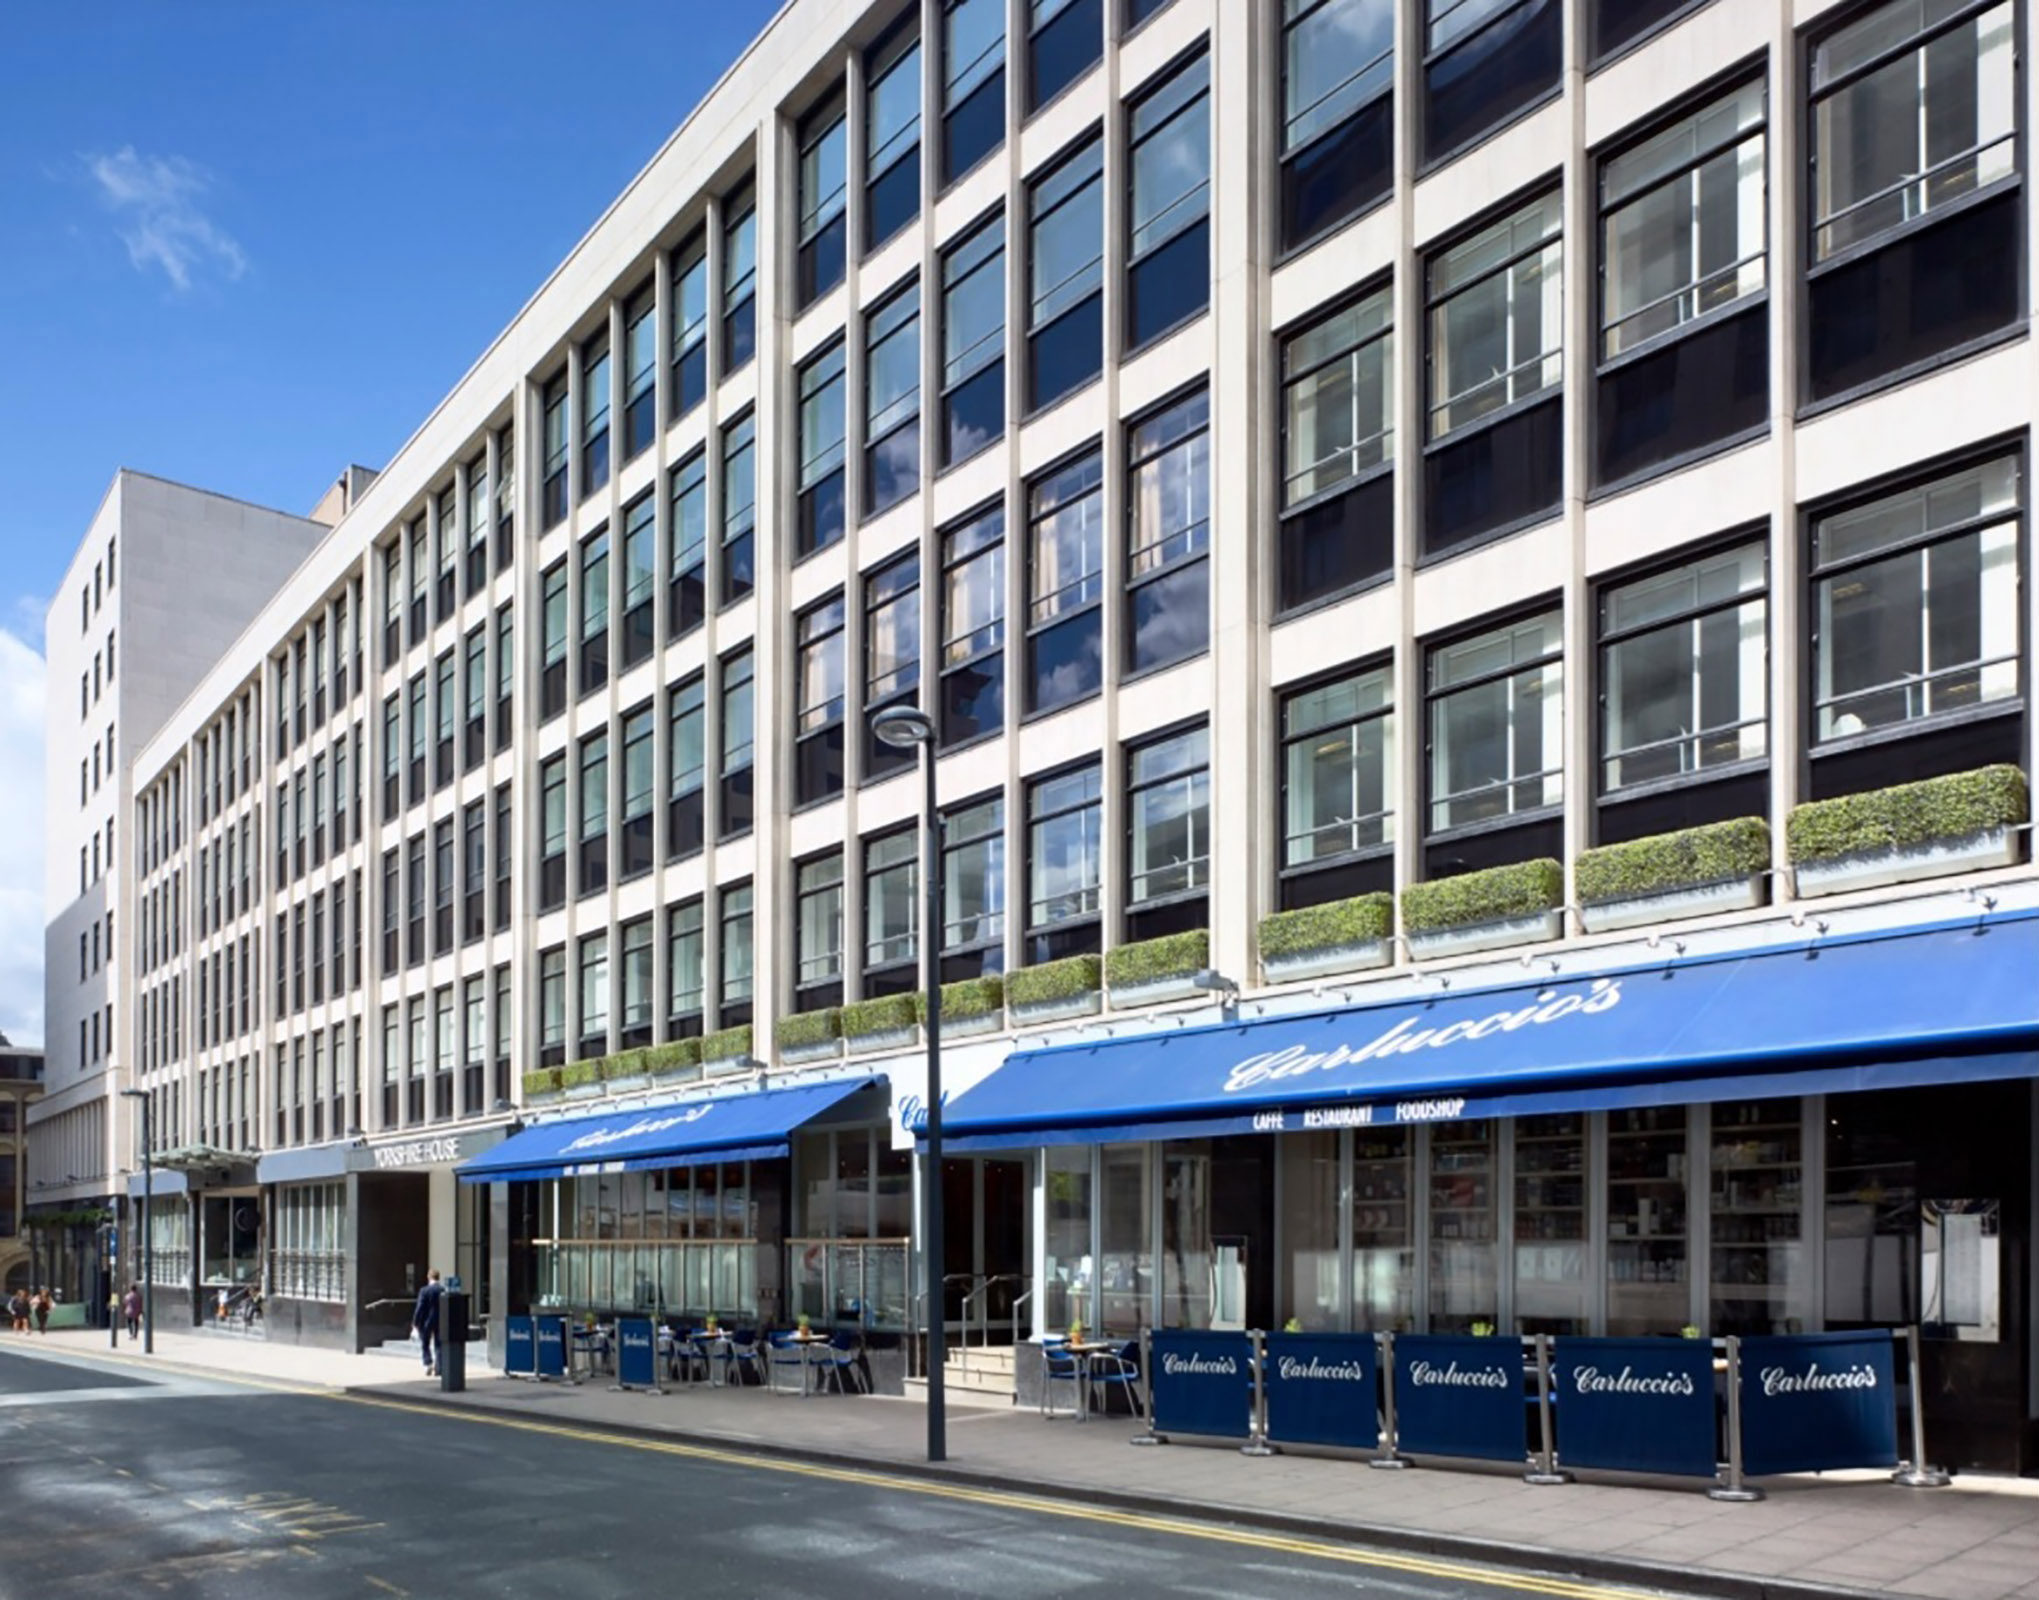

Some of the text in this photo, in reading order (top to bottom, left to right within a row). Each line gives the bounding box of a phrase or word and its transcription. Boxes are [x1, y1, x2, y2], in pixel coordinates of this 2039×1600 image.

[1223, 977, 1623, 1092] Carluccio's
[1303, 1105, 1373, 1128] RESTAURANT
[1395, 1097, 1466, 1122] FOODSHOP
[424, 1137, 461, 1162] HOUSE
[1163, 1352, 1237, 1375] Carluccio's
[1278, 1356, 1362, 1381] Carluccio's
[1409, 1360, 1508, 1388] Carluccio's
[1573, 1365, 1694, 1396] Carluccio's
[1760, 1363, 1877, 1396] Carluccio's
